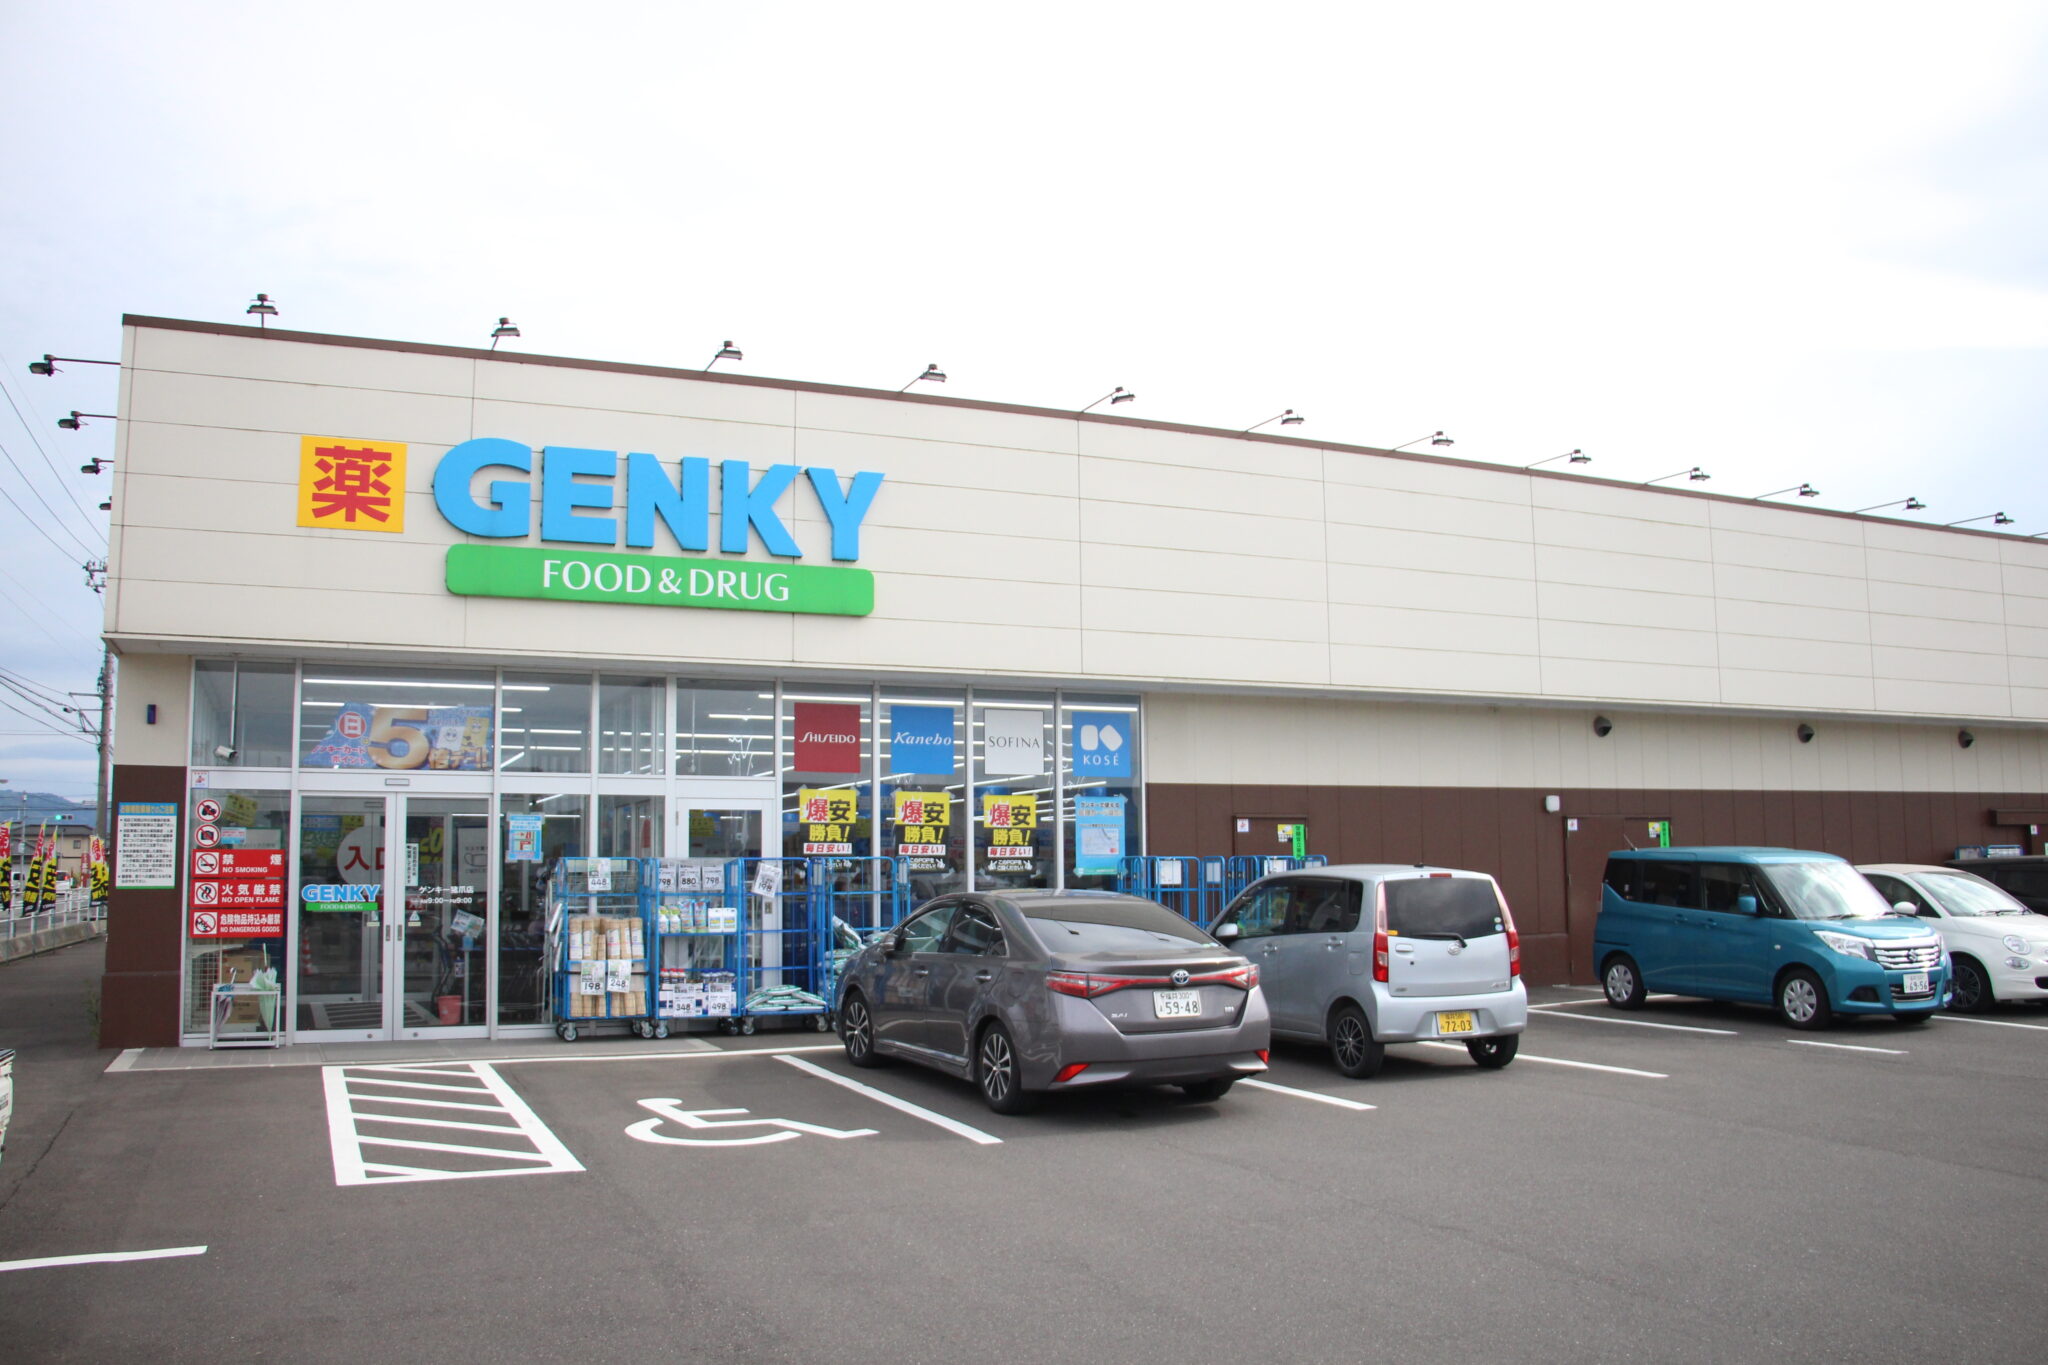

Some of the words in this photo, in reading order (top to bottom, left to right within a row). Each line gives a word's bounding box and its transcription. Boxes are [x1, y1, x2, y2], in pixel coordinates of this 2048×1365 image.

[311, 446, 392, 522] 薬
[432, 437, 885, 561] GENKY
[543, 560, 650, 593] FOOD
[658, 574, 682, 594] &
[690, 569, 790, 601] DRUG
[798, 732, 856, 744] SHISEIDO
[894, 732, 952, 746] Kanebo
[988, 734, 1040, 749] SOFINA
[1083, 751, 1119, 766] KOSÉ
[806, 799, 851, 821] 爆安
[902, 801, 944, 823] 爆安
[990, 804, 1031, 826] 爆安
[221, 884, 281, 895] 火気厳禁
[302, 884, 381, 902] GENKY
[1165, 1000, 1199, 1014] 59-48
